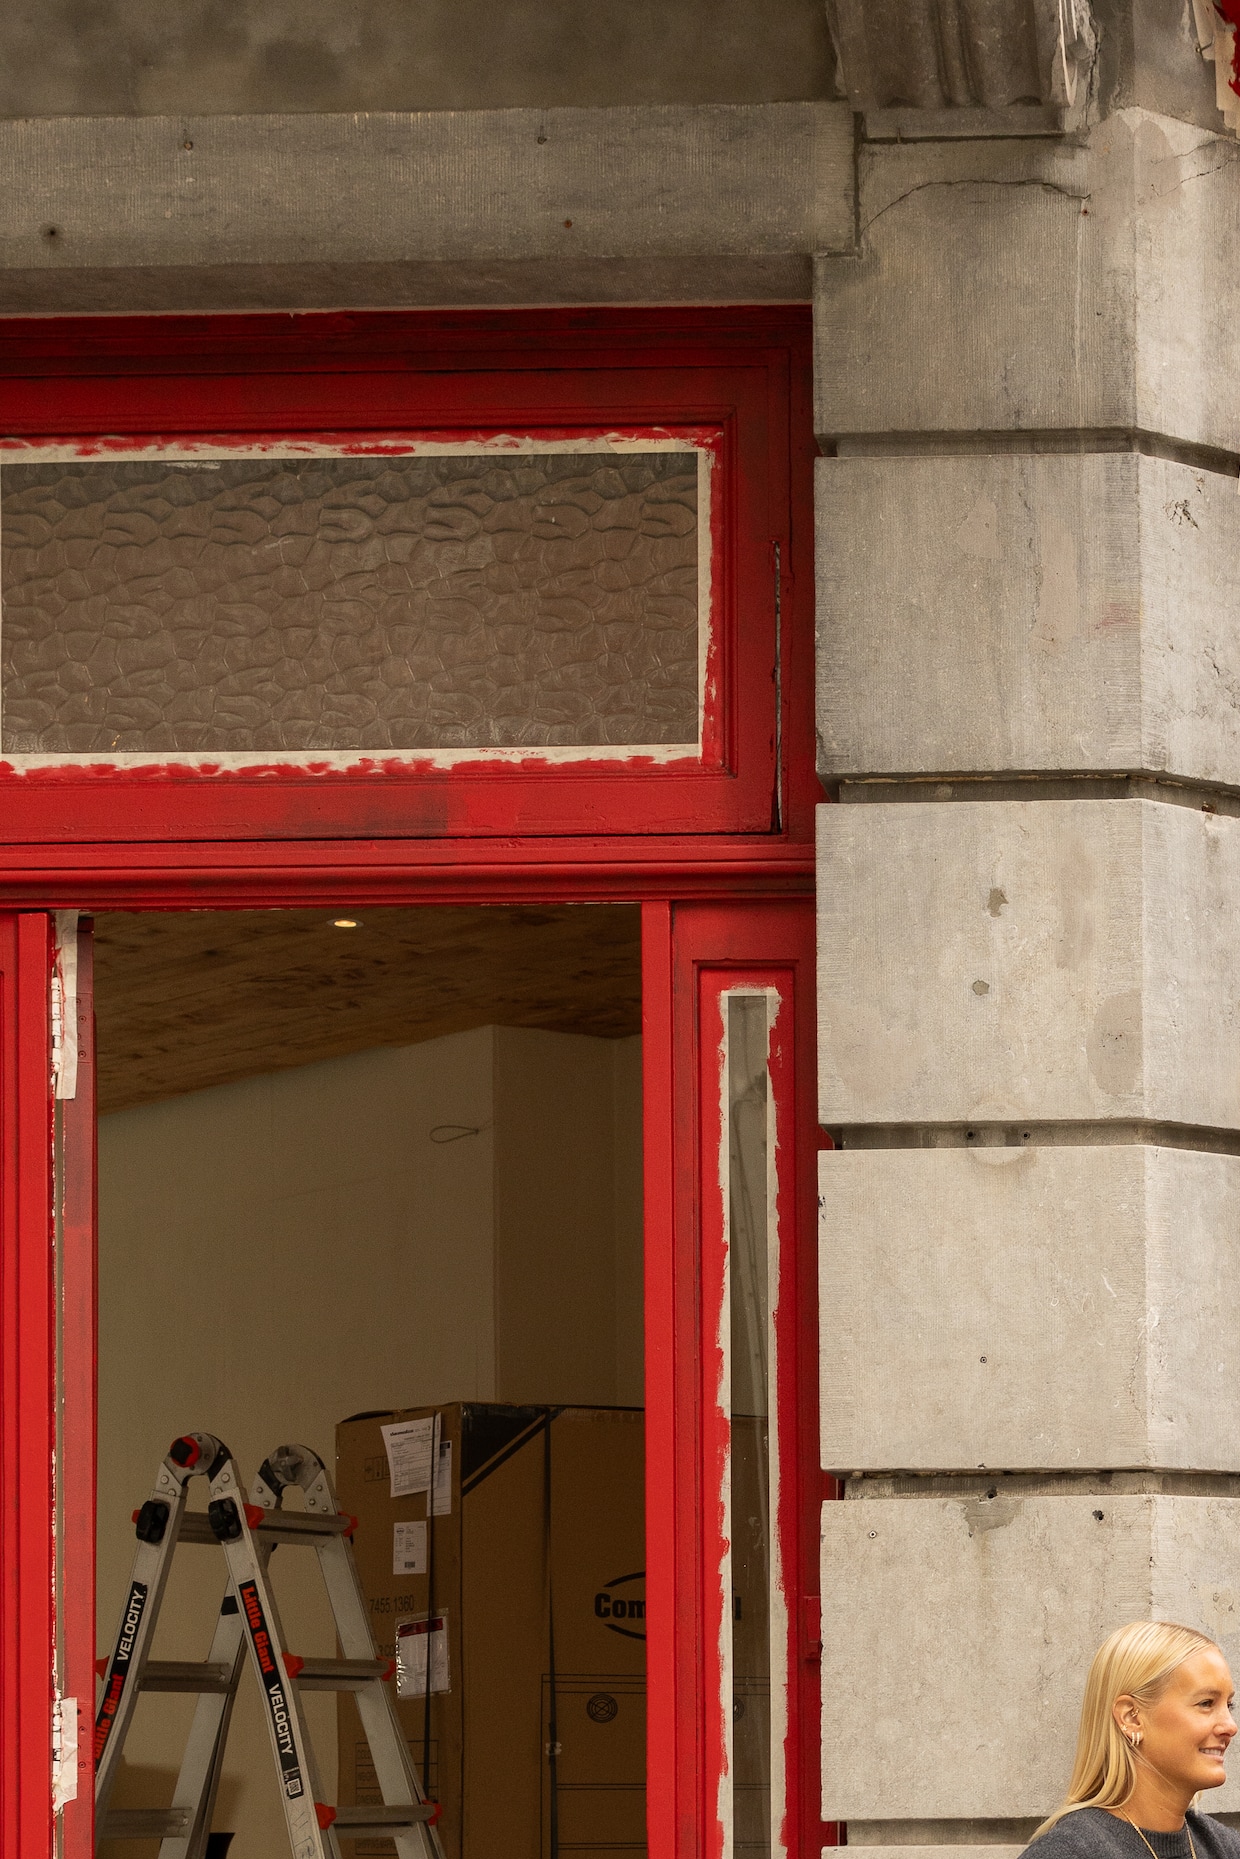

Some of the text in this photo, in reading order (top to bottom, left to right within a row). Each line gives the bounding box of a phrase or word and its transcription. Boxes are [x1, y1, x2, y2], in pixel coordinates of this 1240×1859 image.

[103, 1672, 125, 1715] Giant
[116, 1589, 145, 1661] VELOCITY
[369, 1594, 415, 1614] 7455.1360
[241, 1584, 294, 1755] Little Giant VELOCITY
